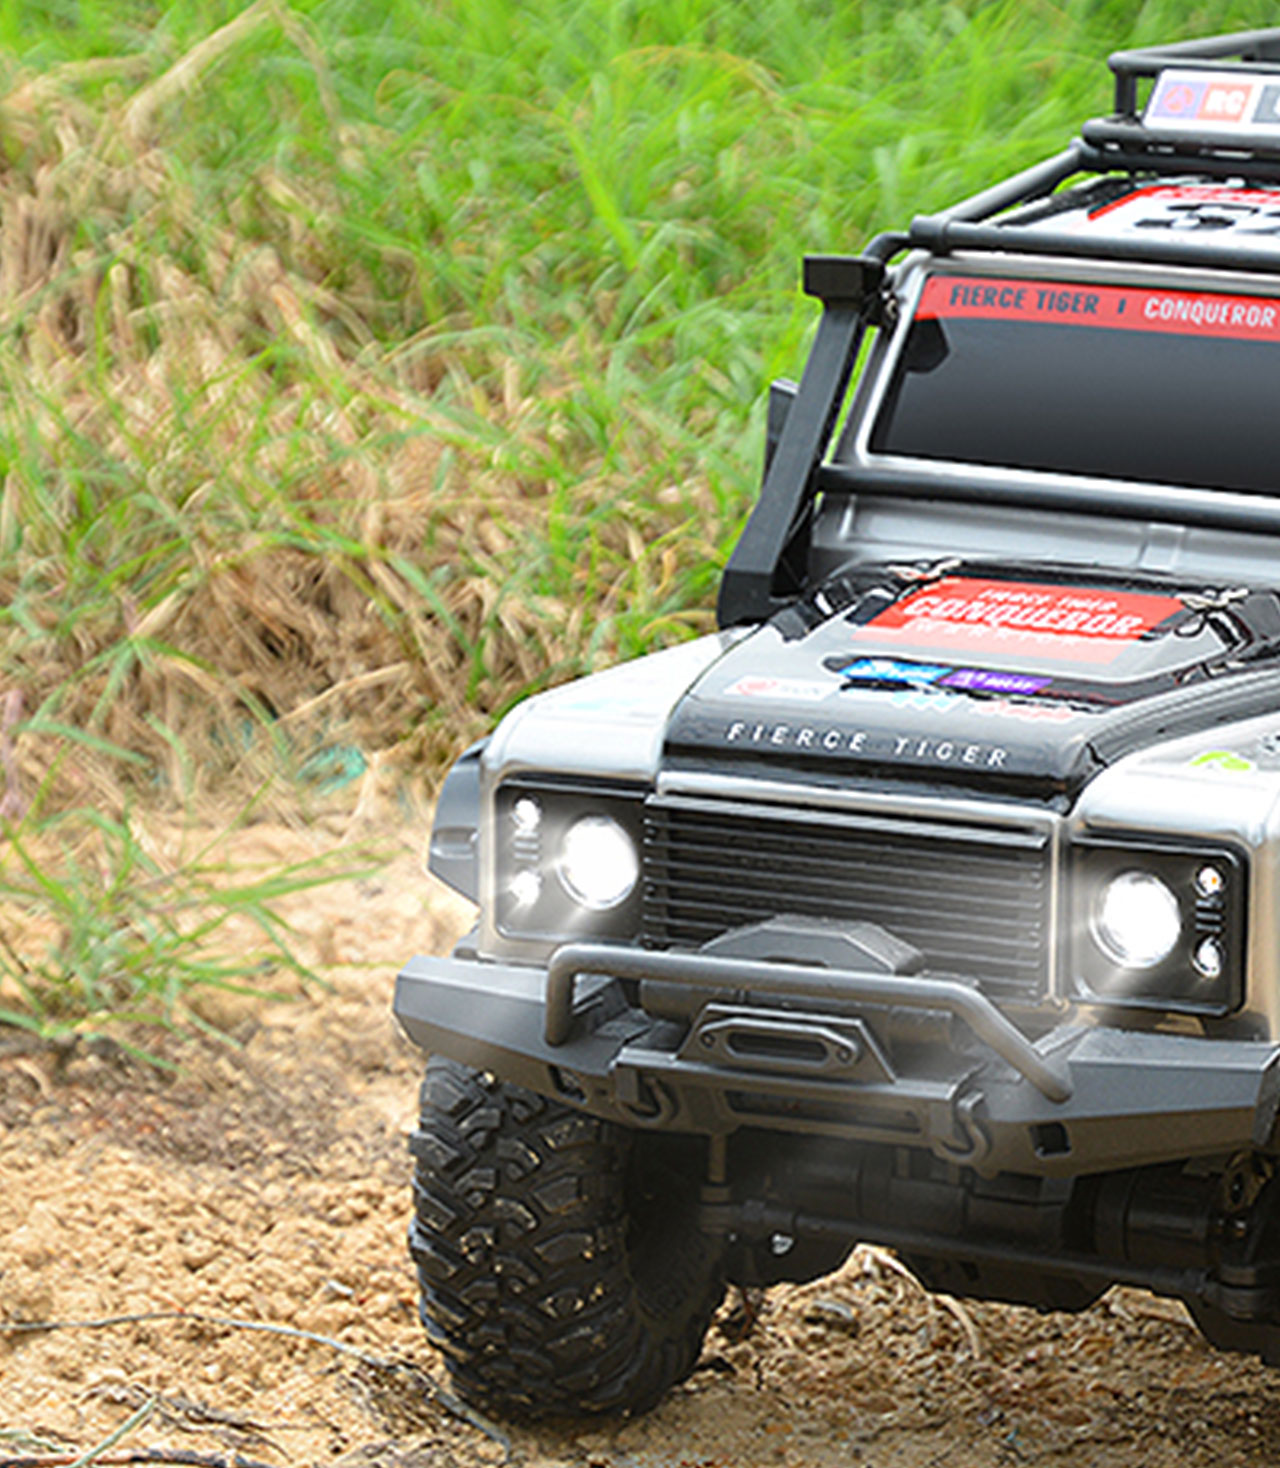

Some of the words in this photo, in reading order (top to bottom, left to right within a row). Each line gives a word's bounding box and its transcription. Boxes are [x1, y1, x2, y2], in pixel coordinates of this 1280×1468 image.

[949, 284, 1028, 309] FIERCE
[1036, 289, 1099, 315] TIGER
[1143, 297, 1276, 328] CONQUEROR
[903, 595, 1144, 635] CONQUEROR
[727, 722, 867, 752] FIERCE
[894, 738, 1009, 768] TIGER
